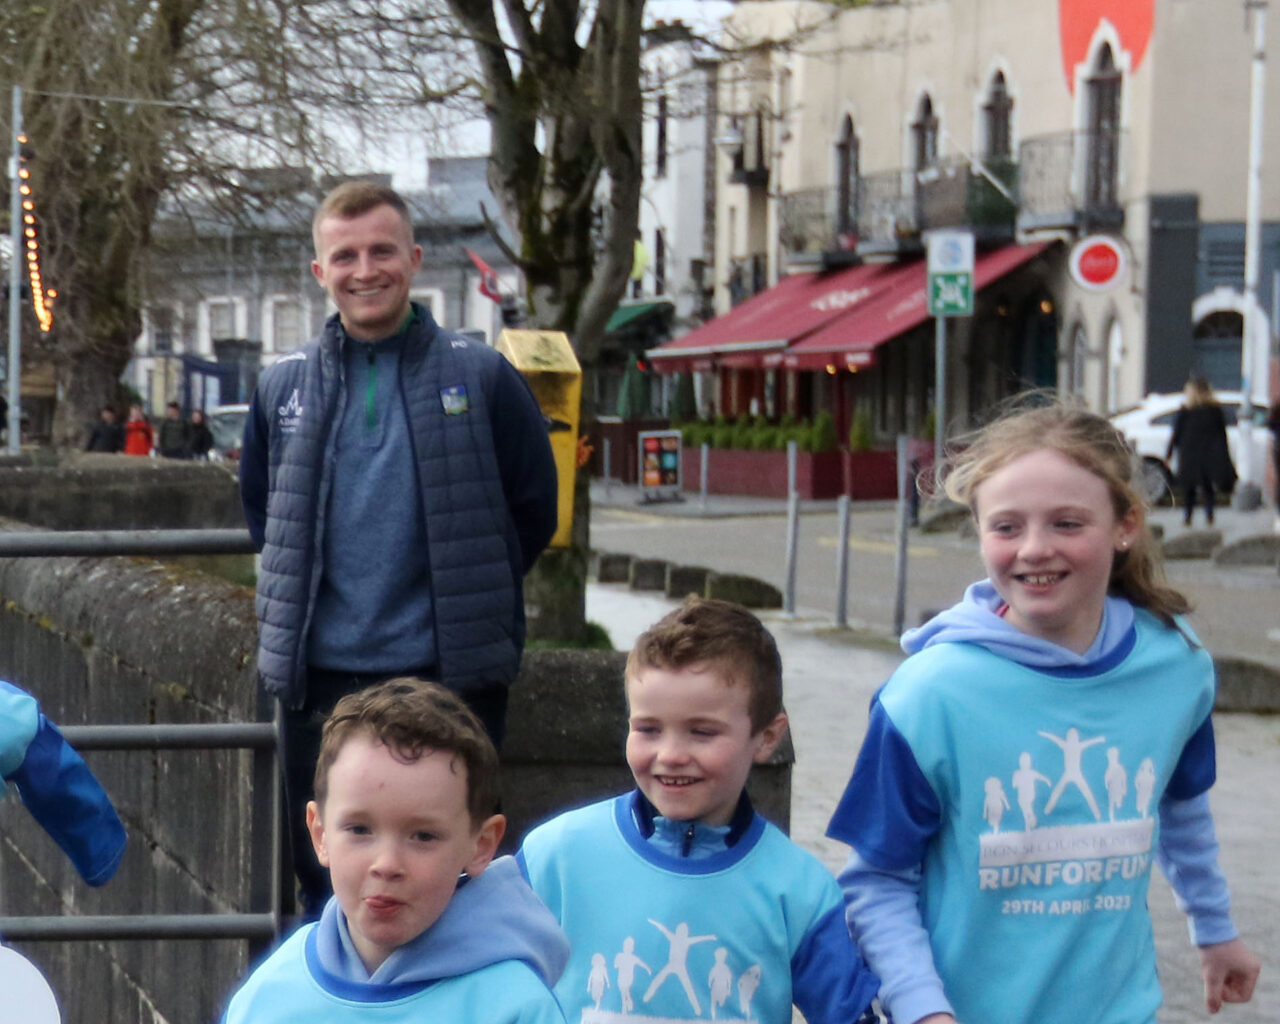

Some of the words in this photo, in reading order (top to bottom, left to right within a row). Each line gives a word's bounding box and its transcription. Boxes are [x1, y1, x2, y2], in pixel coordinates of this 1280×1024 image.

[978, 863, 1041, 890] RUN
[1045, 860, 1103, 886] FOR
[1105, 853, 1150, 880] FUN
[1002, 900, 1044, 914] 29TH
